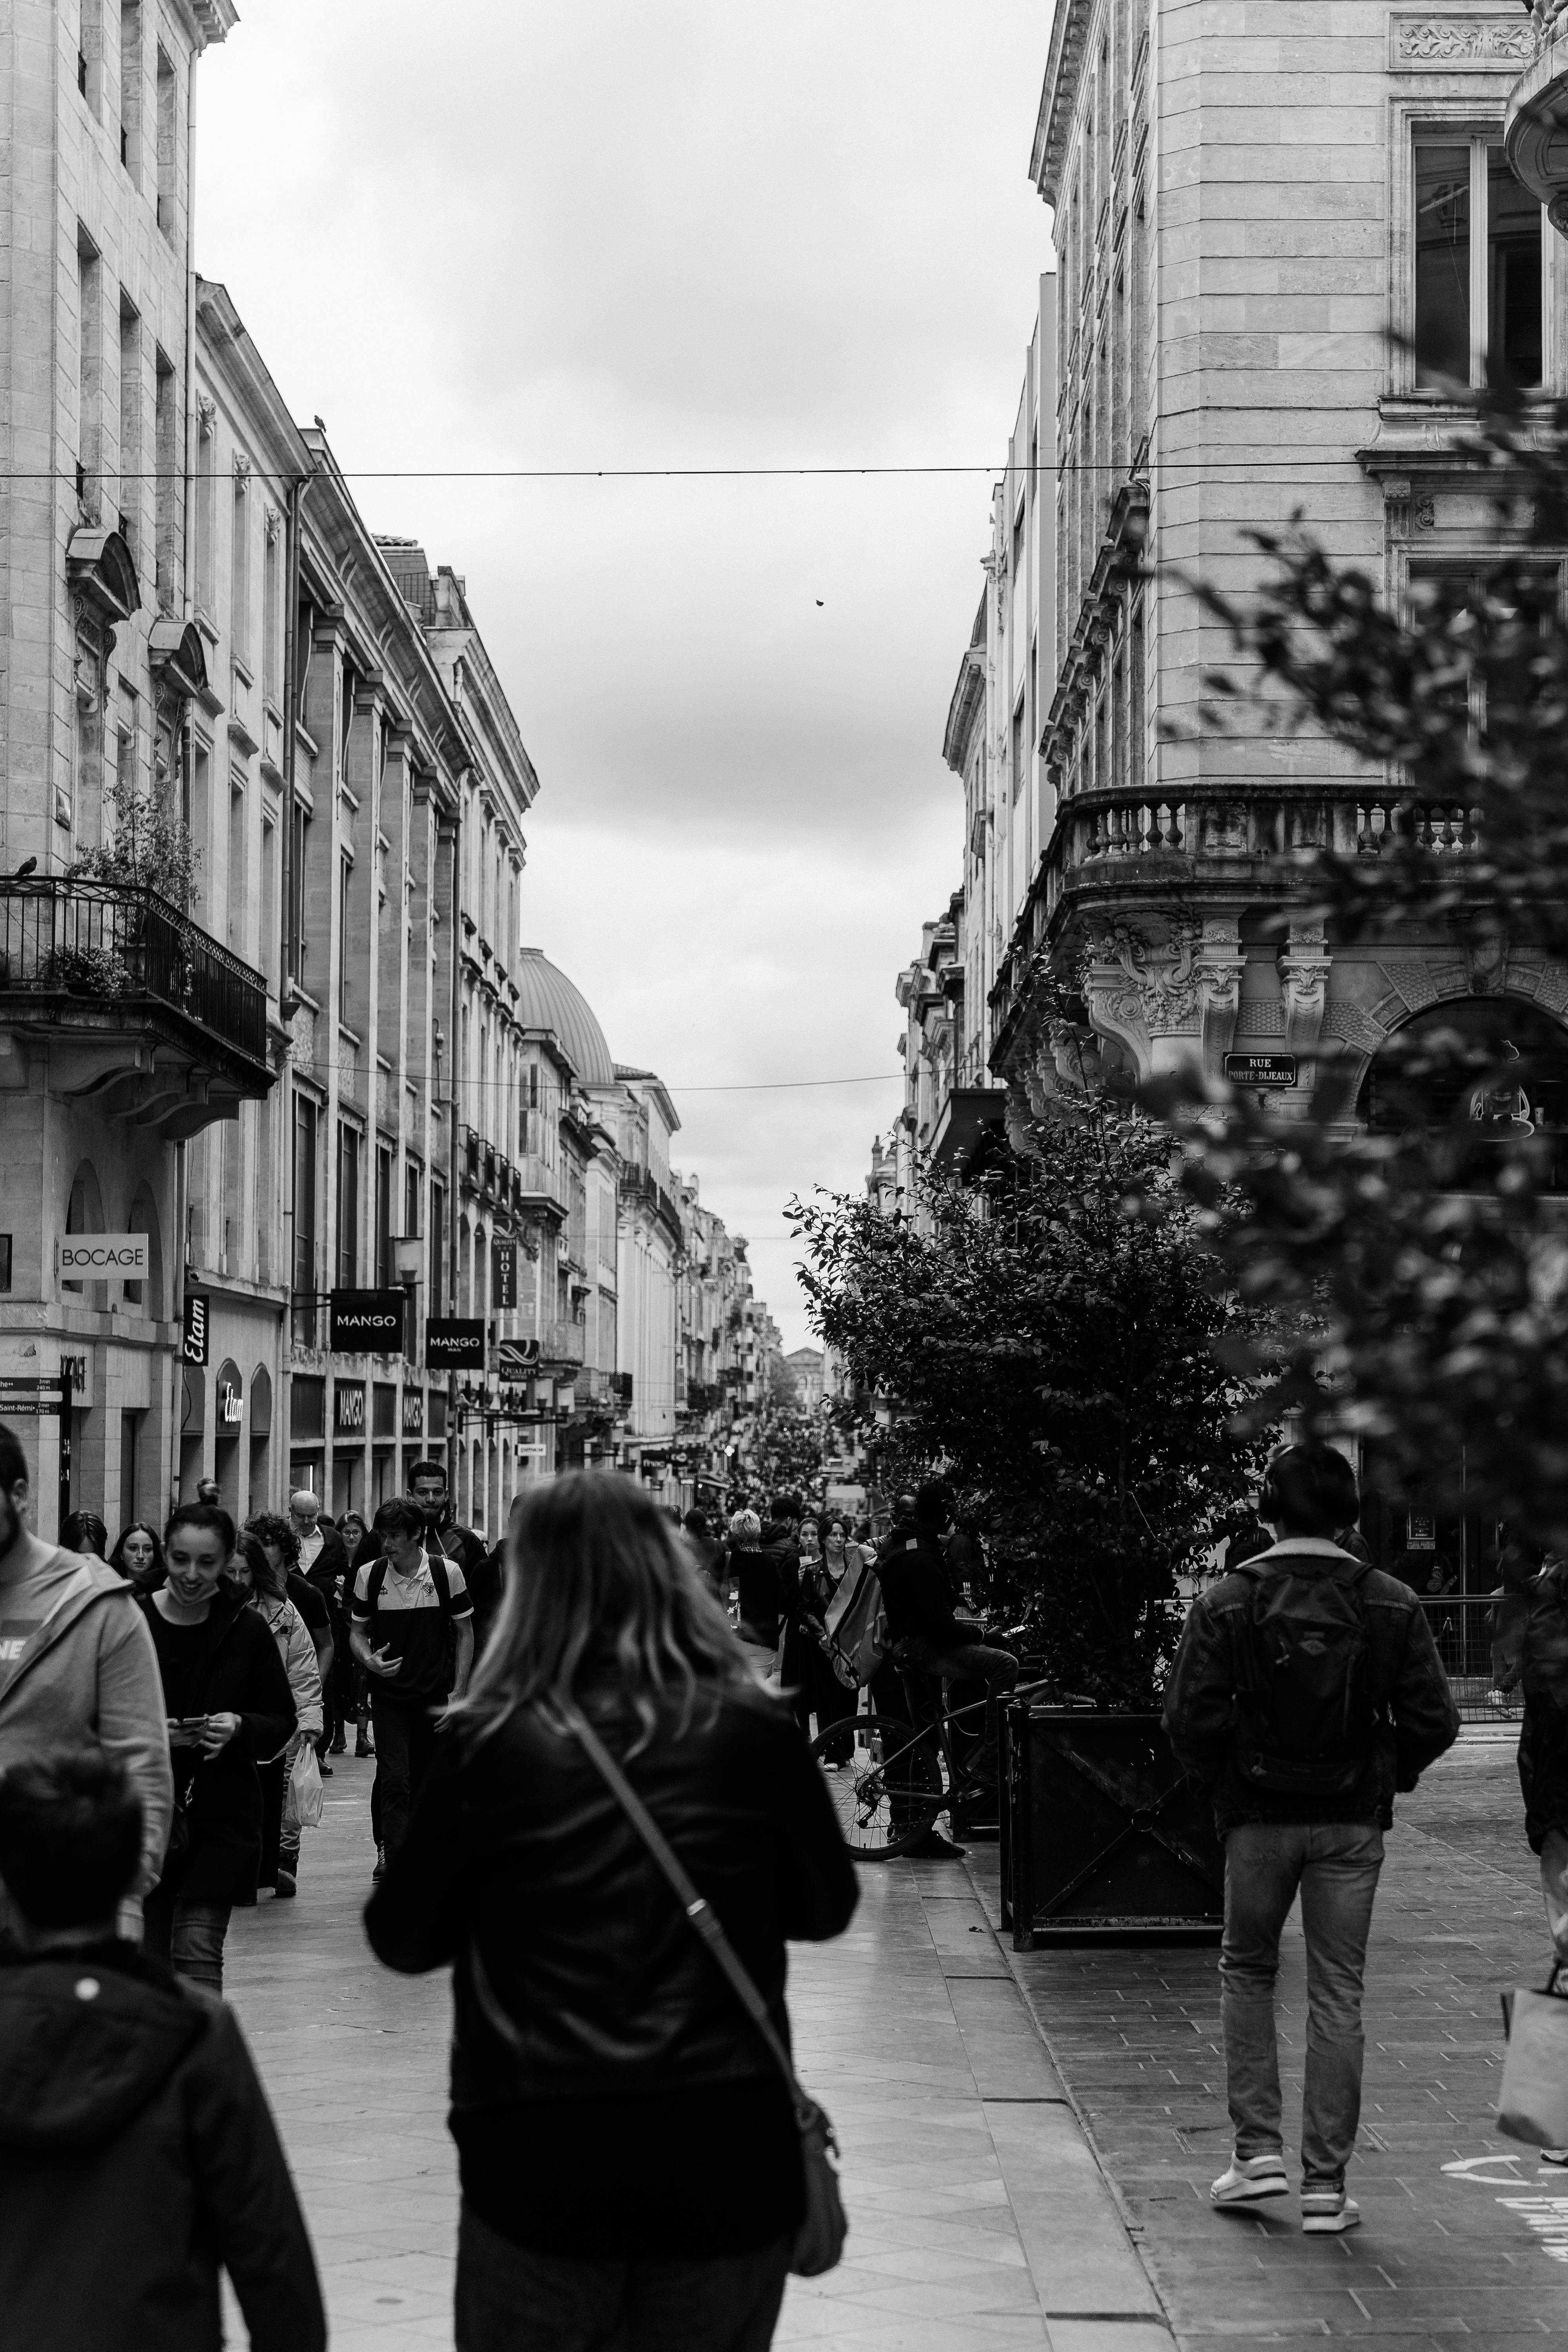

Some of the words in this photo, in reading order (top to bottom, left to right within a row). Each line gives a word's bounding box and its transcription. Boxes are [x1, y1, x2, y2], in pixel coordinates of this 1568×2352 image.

[1249, 1058, 1271, 1068] RUE
[1228, 1071, 1293, 1080] PORTE-DIJEAUX
[62, 1249, 143, 1266] BOCAGE
[500, 1251, 510, 1305] HOTEL
[337, 1315, 396, 1327] MANGO
[185, 1299, 204, 1363] Etam
[430, 1337, 480, 1347] MANGO
[339, 1390, 363, 1426] MANGO
[643, 1459, 665, 1468] fnac
